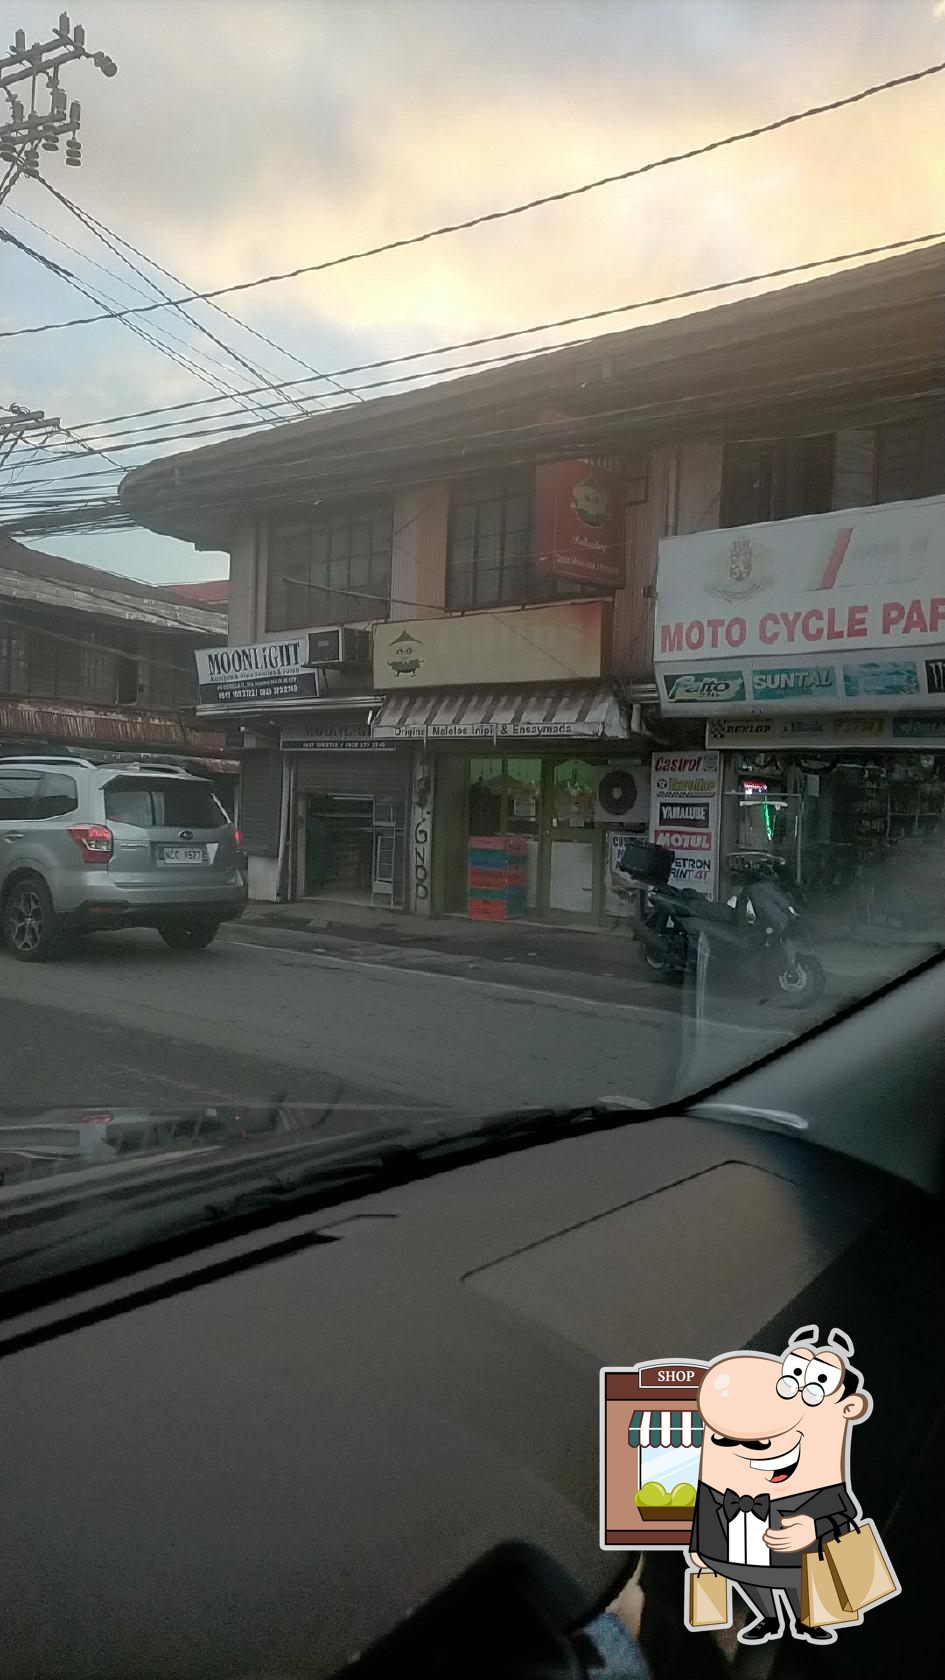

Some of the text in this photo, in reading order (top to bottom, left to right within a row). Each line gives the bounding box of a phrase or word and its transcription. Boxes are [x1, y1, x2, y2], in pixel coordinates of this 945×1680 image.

[660, 616, 747, 653] MOTO
[758, 604, 869, 645] CYCLE
[754, 671, 832, 690] SUNTAL
[500, 725, 508, 735] &
[512, 724, 572, 736] Ensaymada
[655, 757, 702, 772] Castrol
[662, 806, 707, 820] YAMALUBE
[656, 832, 710, 849] MOTUL
